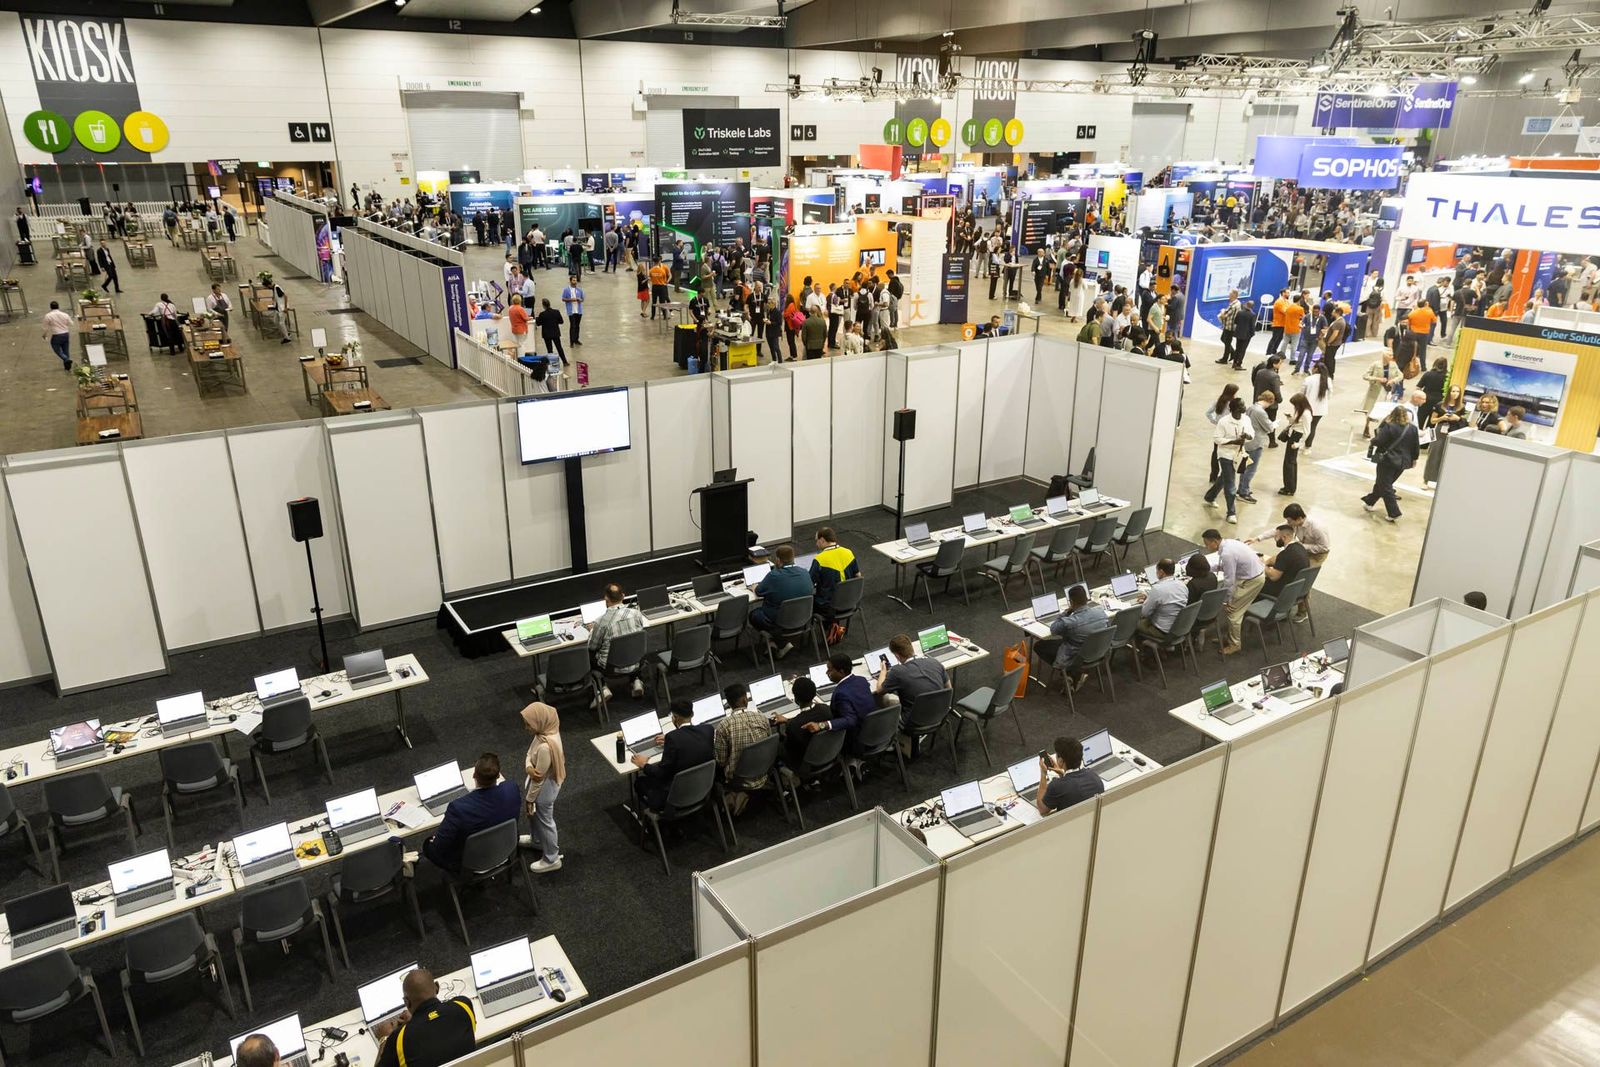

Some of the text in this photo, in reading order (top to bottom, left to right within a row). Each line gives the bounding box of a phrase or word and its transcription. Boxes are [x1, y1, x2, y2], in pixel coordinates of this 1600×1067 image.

[449, 20, 461, 30] 12
[684, 32, 694, 40] 13
[23, 18, 135, 83] KIOSK
[974, 60, 1018, 100] KIOSK
[1335, 98, 1397, 109] SentinelOne
[1414, 98, 1452, 109] SentinelOne
[707, 127, 771, 138] Triskele Labs
[1312, 157, 1398, 178] SOPHOS
[1427, 197, 1600, 229] THALES
[1541, 328, 1569, 339] Cyber
[1511, 352, 1544, 363] tesserent
